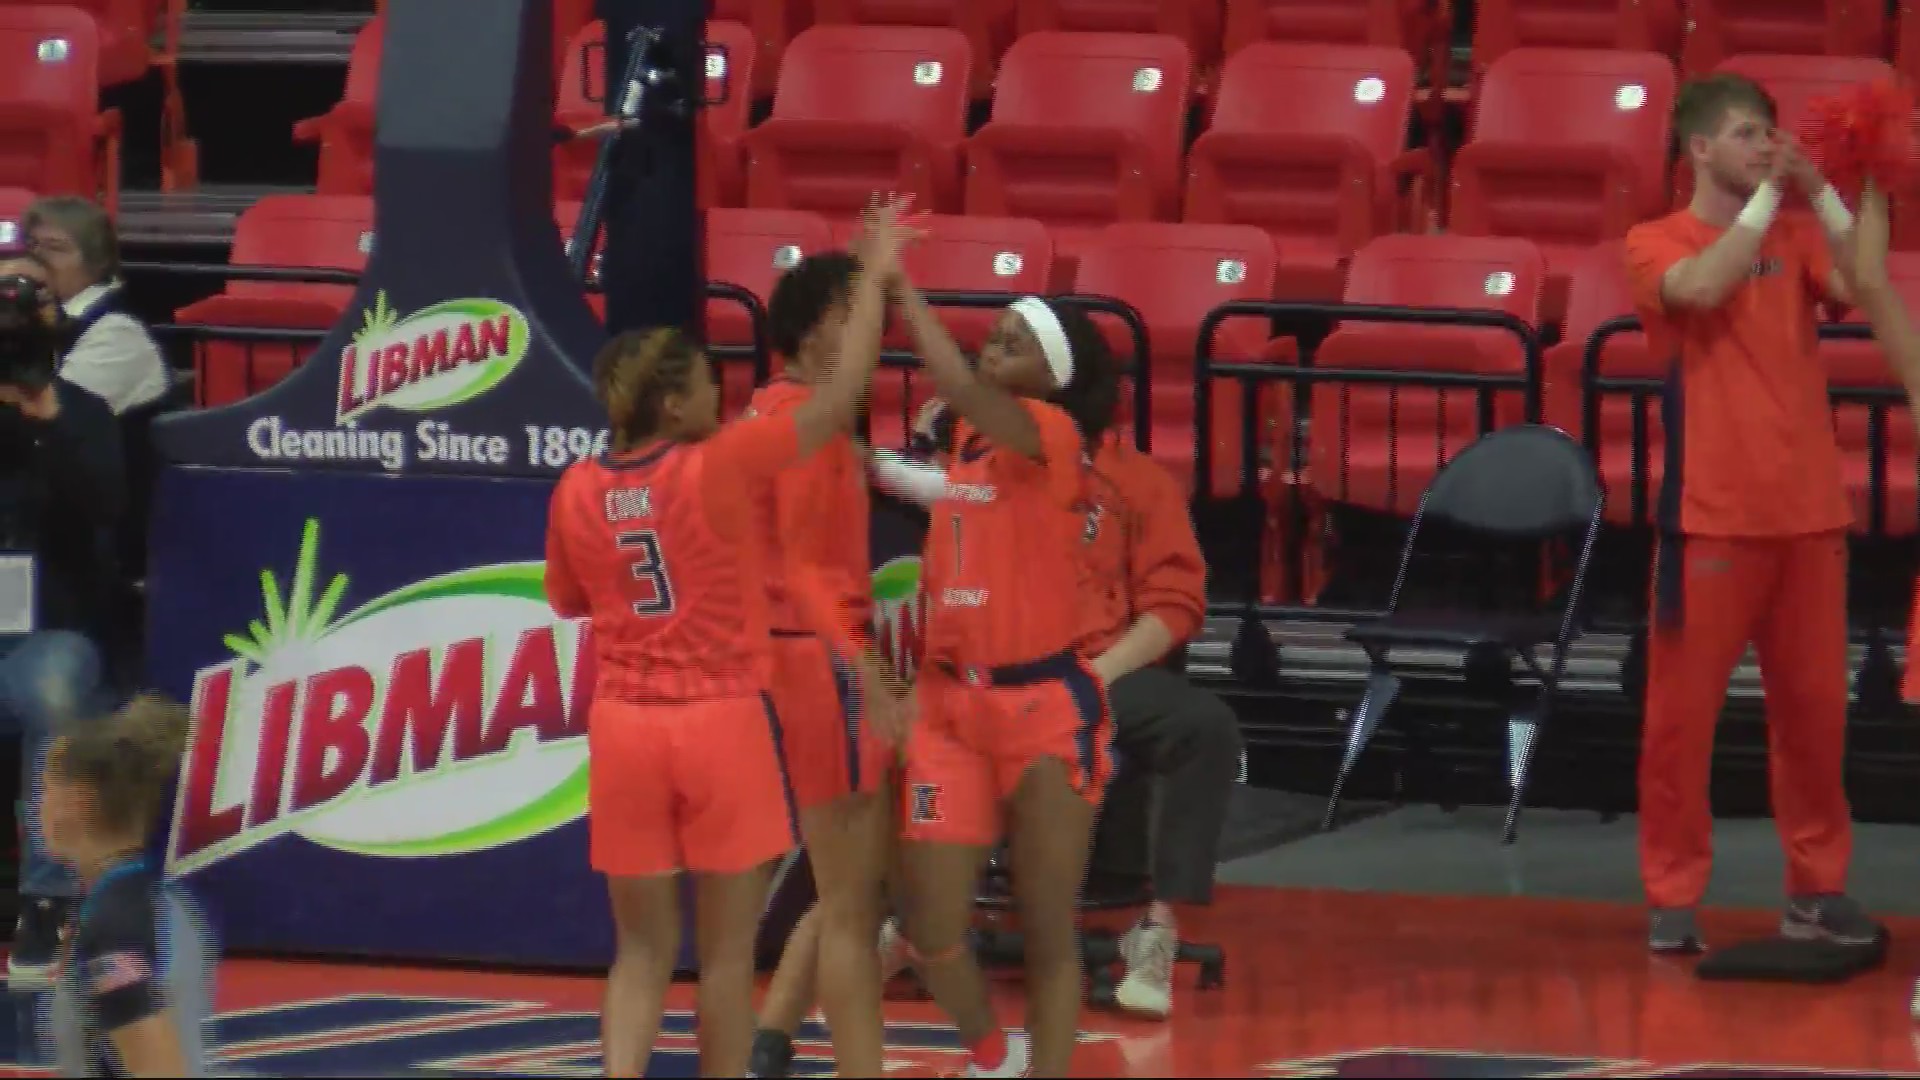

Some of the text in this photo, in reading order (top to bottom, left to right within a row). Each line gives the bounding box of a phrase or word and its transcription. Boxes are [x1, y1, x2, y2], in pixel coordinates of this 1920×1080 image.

[338, 313, 512, 416] LIBMAN
[247, 415, 404, 469] Cleaning
[416, 420, 509, 463] Since
[604, 486, 652, 521] COOK
[615, 530, 675, 617] 3
